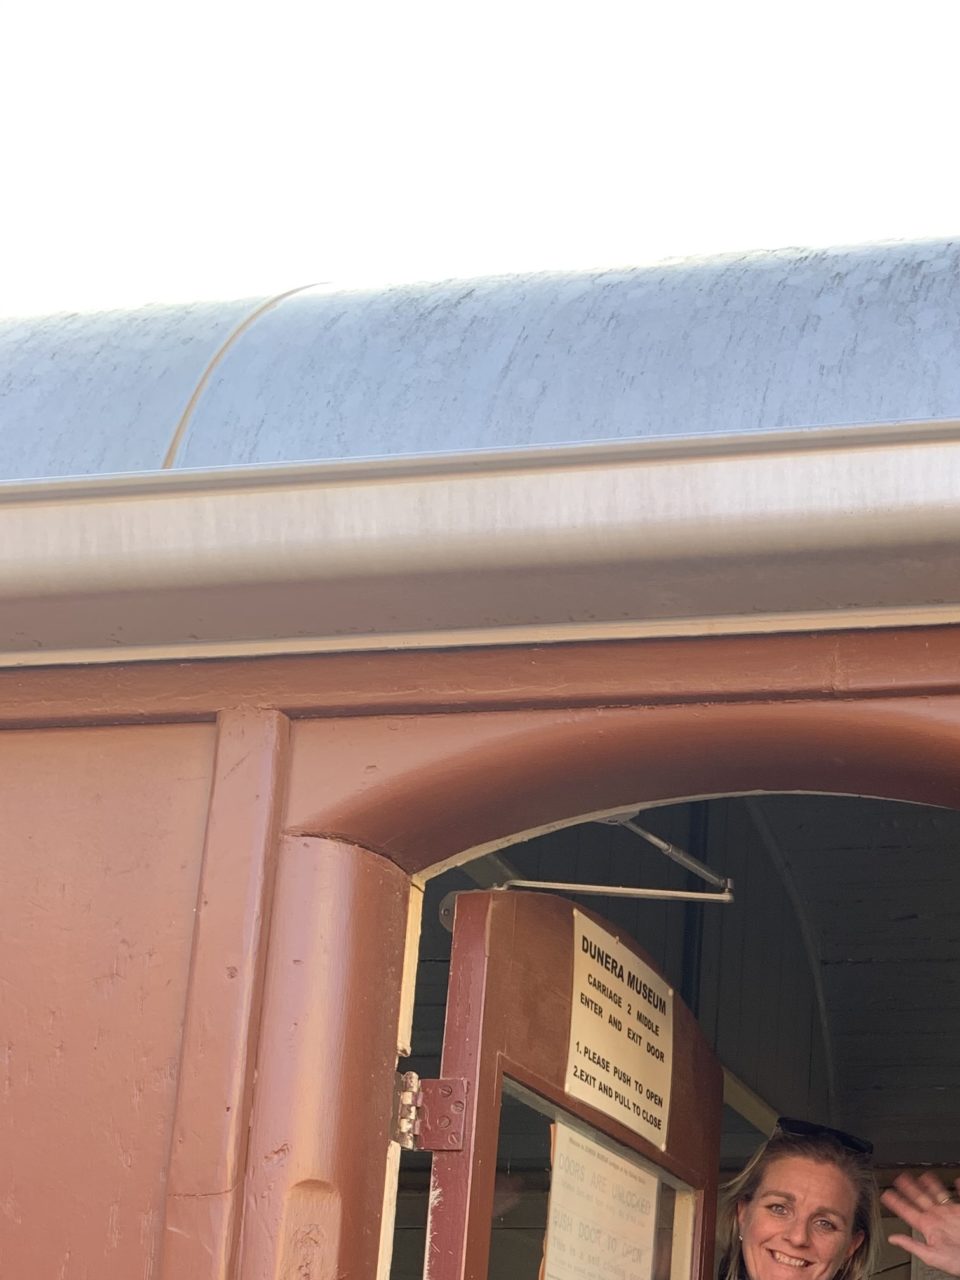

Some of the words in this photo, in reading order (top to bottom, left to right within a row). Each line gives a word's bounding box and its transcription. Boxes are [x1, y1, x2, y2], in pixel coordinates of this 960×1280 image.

[581, 935, 625, 983] DUNERA
[626, 971, 667, 1016] MUSEUM
[587, 973, 623, 1008] CARRIAGE
[627, 1003, 632, 1015] 2
[636, 1010, 660, 1036] MIDDLE
[580, 992, 603, 1018] ENTER
[608, 1014, 623, 1032] AND
[627, 1028, 643, 1047] EXIT
[646, 1042, 665, 1063] DOOR
[573, 1065, 597, 1088] 2.EXIT
[598, 1082, 613, 1098] AND
[614, 1091, 631, 1110] PULL
[632, 1102, 641, 1117] TO
[641, 1110, 662, 1130] CLOSE
[576, 1041, 582, 1054] 1.
[583, 1046, 611, 1073] PLEASE
[613, 1066, 632, 1087] PUSH
[634, 1080, 643, 1095] TO
[645, 1089, 664, 1108] OPEN
